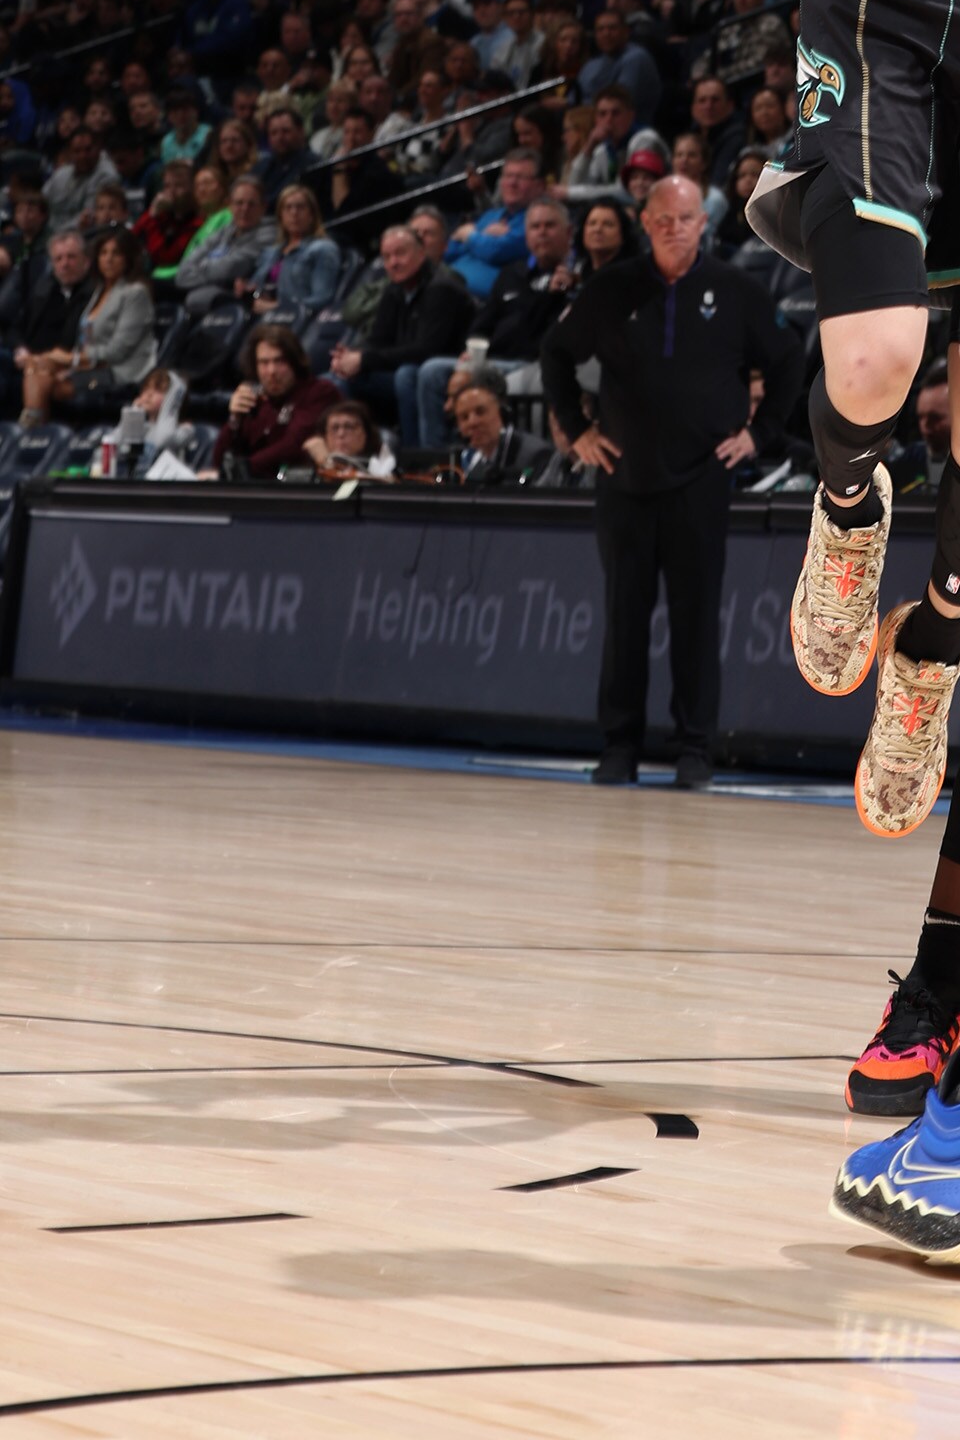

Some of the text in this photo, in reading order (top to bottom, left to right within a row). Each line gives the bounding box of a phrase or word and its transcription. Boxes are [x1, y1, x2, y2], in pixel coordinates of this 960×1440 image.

[105, 566, 302, 633] PENTAIR
[347, 572, 504, 665] Helping
[518, 579, 594, 655] The
